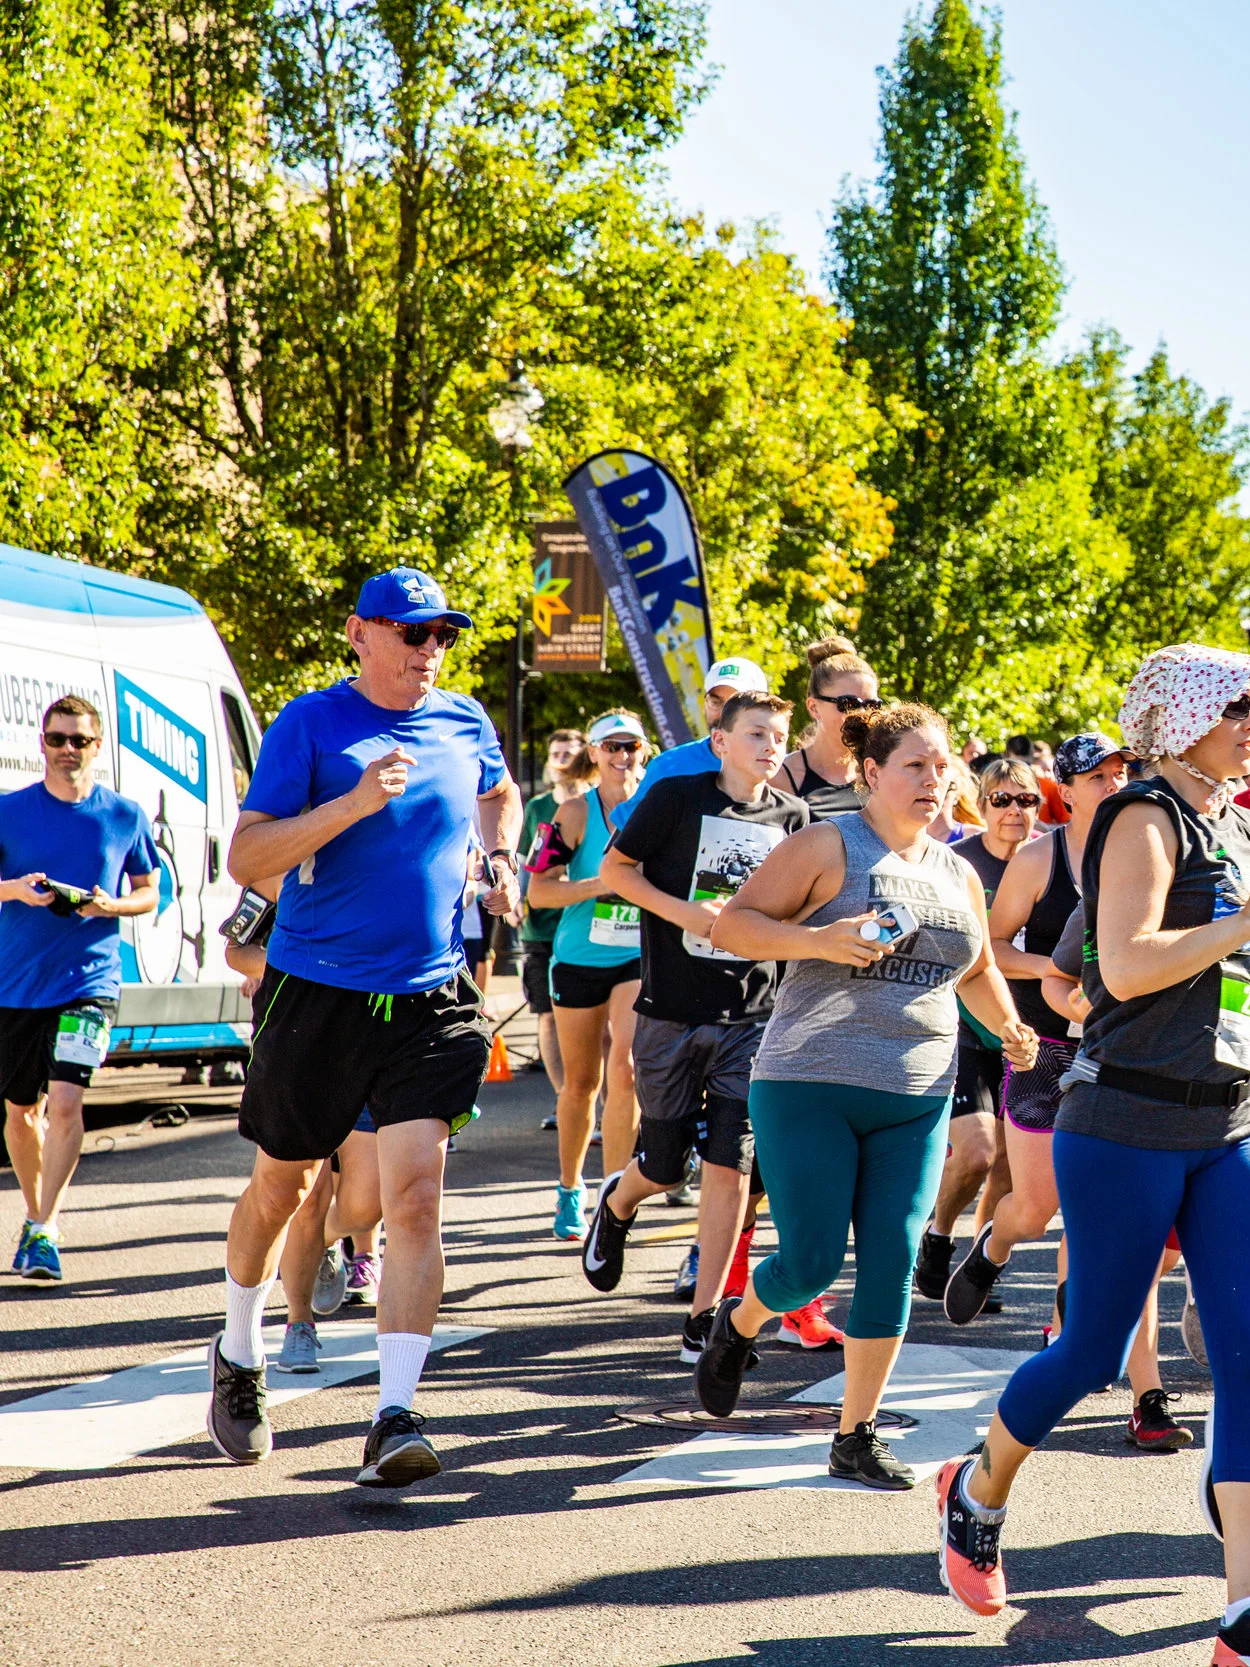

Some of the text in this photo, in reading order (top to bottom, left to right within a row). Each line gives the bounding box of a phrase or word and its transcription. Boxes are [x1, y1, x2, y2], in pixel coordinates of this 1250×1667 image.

[586, 488, 611, 536] Building
[611, 551, 625, 573] Our
[620, 573, 648, 634] Reputation
[599, 466, 703, 634] BnK
[565, 644, 601, 653] STREET
[570, 624, 601, 633] GREAT
[608, 584, 676, 750] BnKConstruction.co
[0, 673, 43, 727] UBER
[124, 690, 200, 785] TIMING
[609, 905, 639, 922] 178
[874, 877, 937, 900] MAKE
